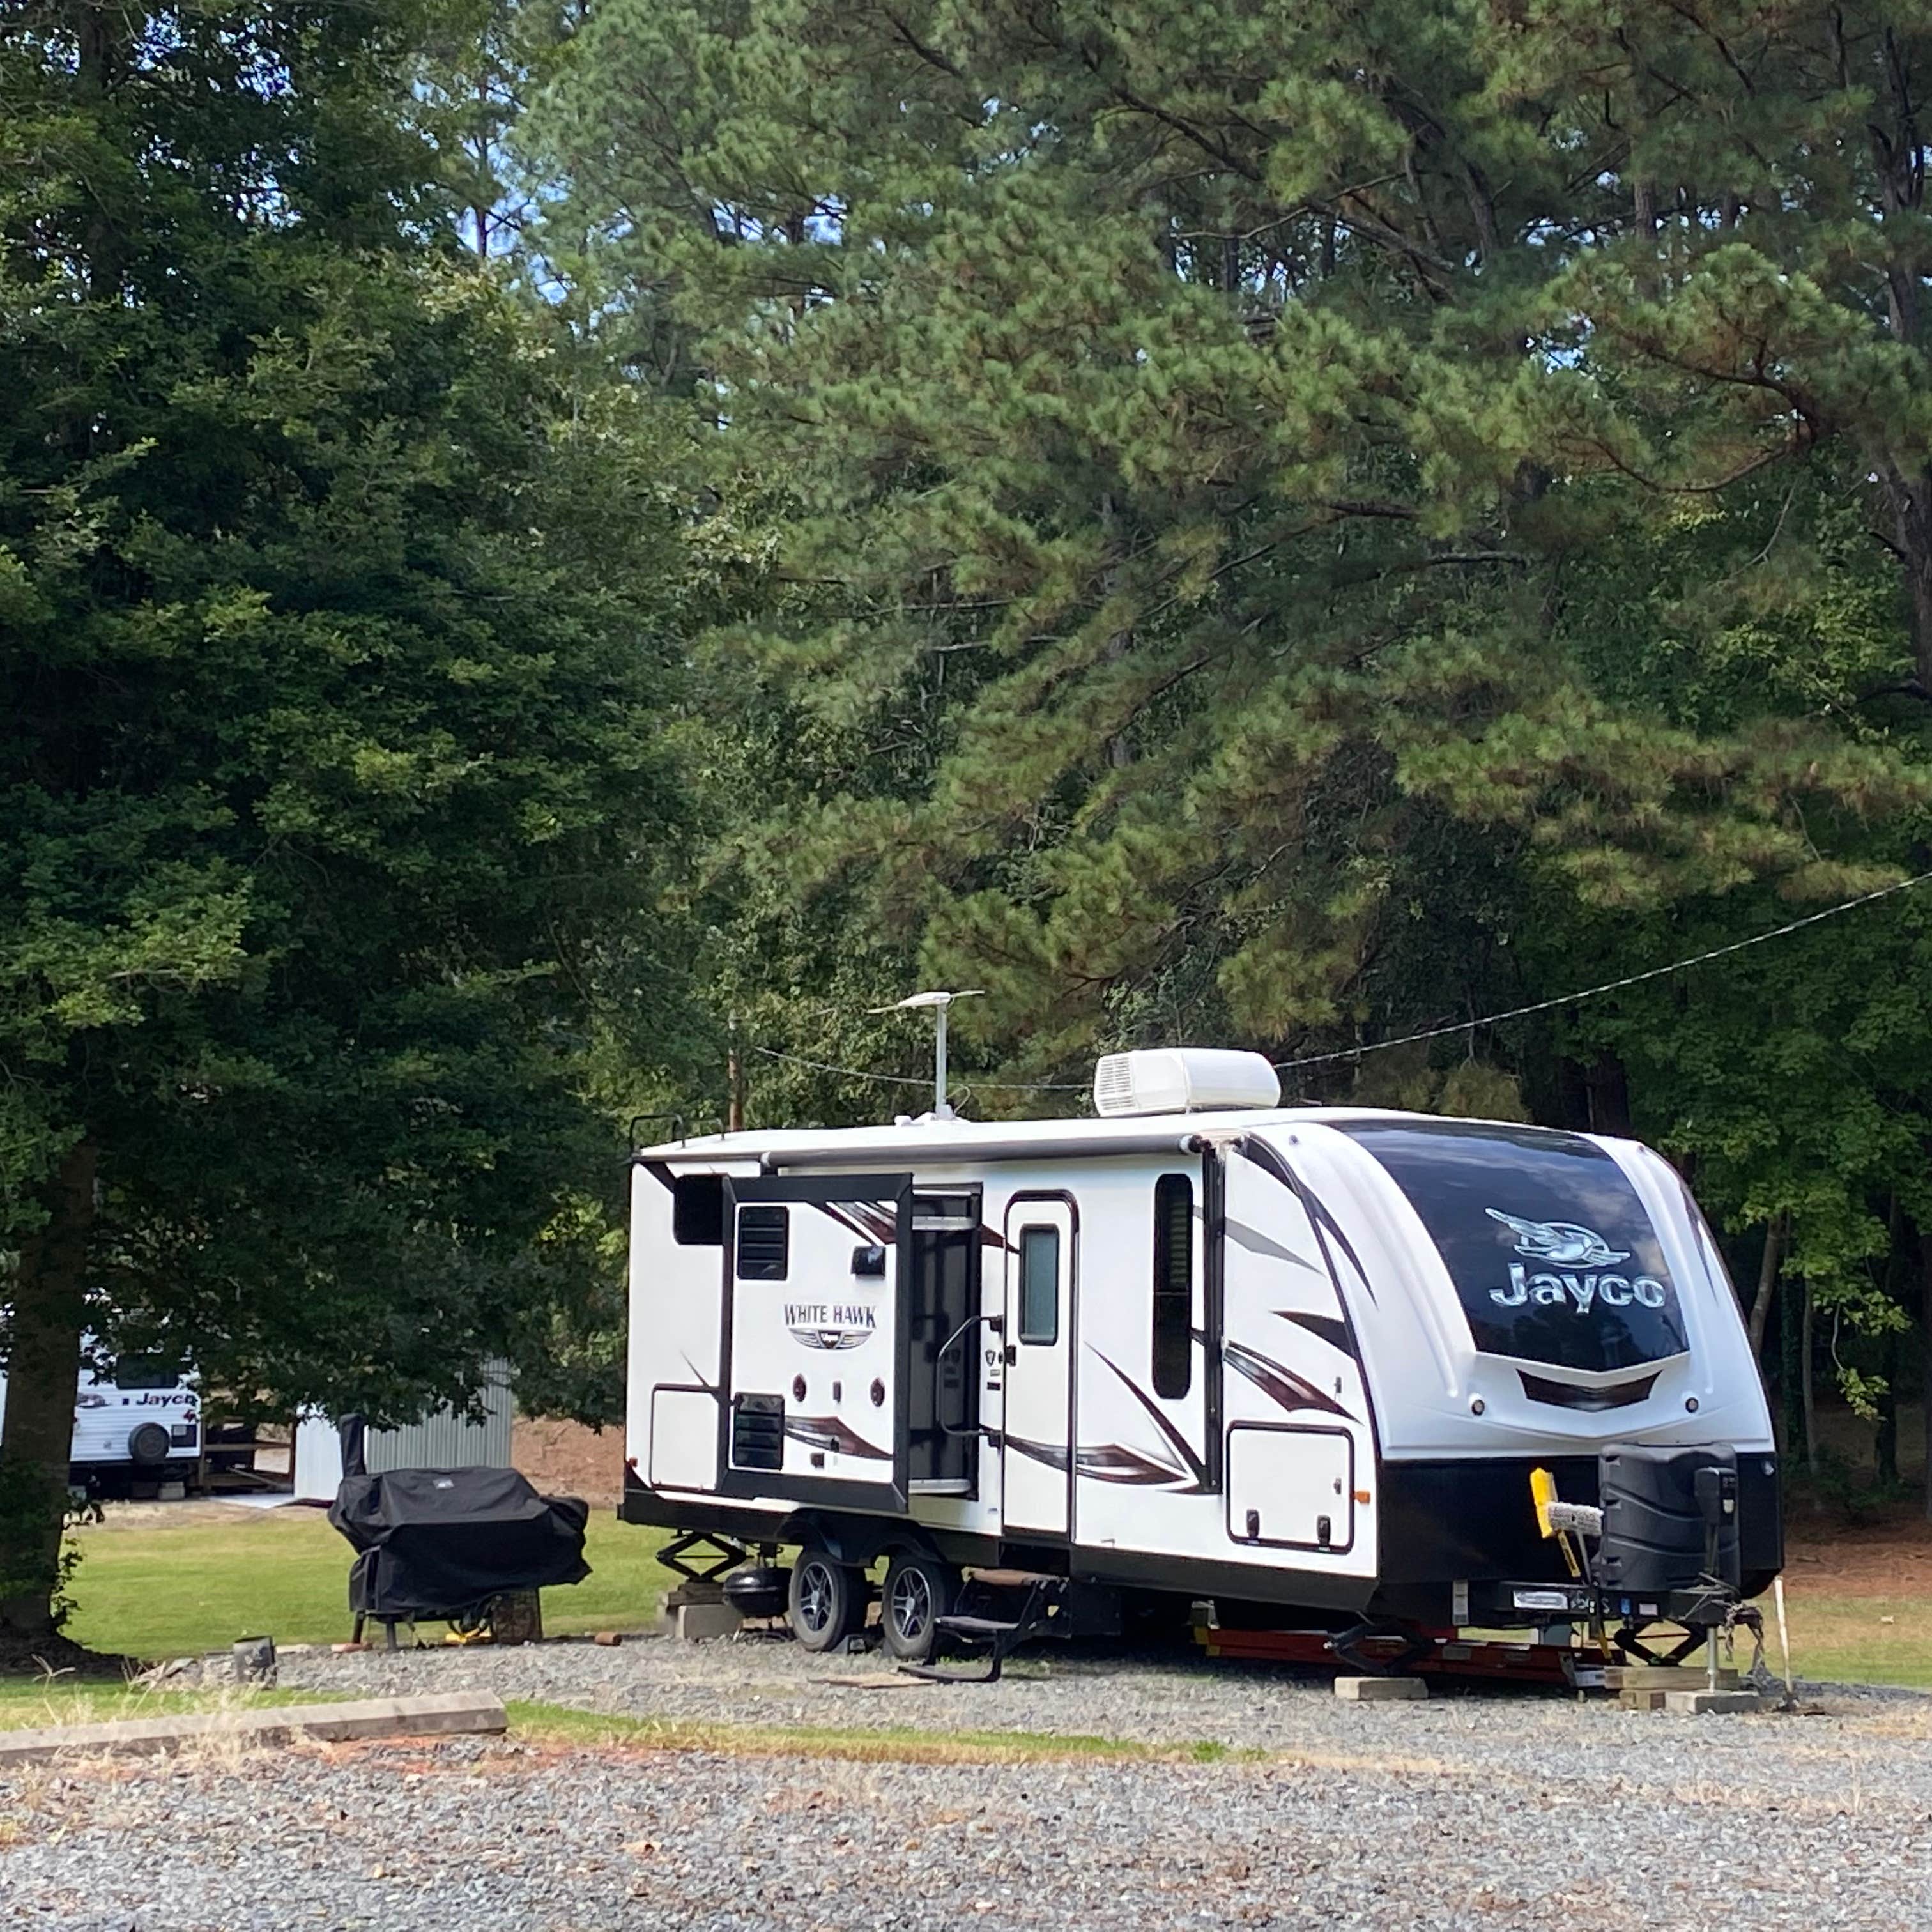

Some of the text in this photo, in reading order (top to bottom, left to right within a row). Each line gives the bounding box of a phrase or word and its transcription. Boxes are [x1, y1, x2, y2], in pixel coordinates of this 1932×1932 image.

[1489, 1262, 1666, 1314] Jayco
[785, 1304, 876, 1328] WHITE HAWK
